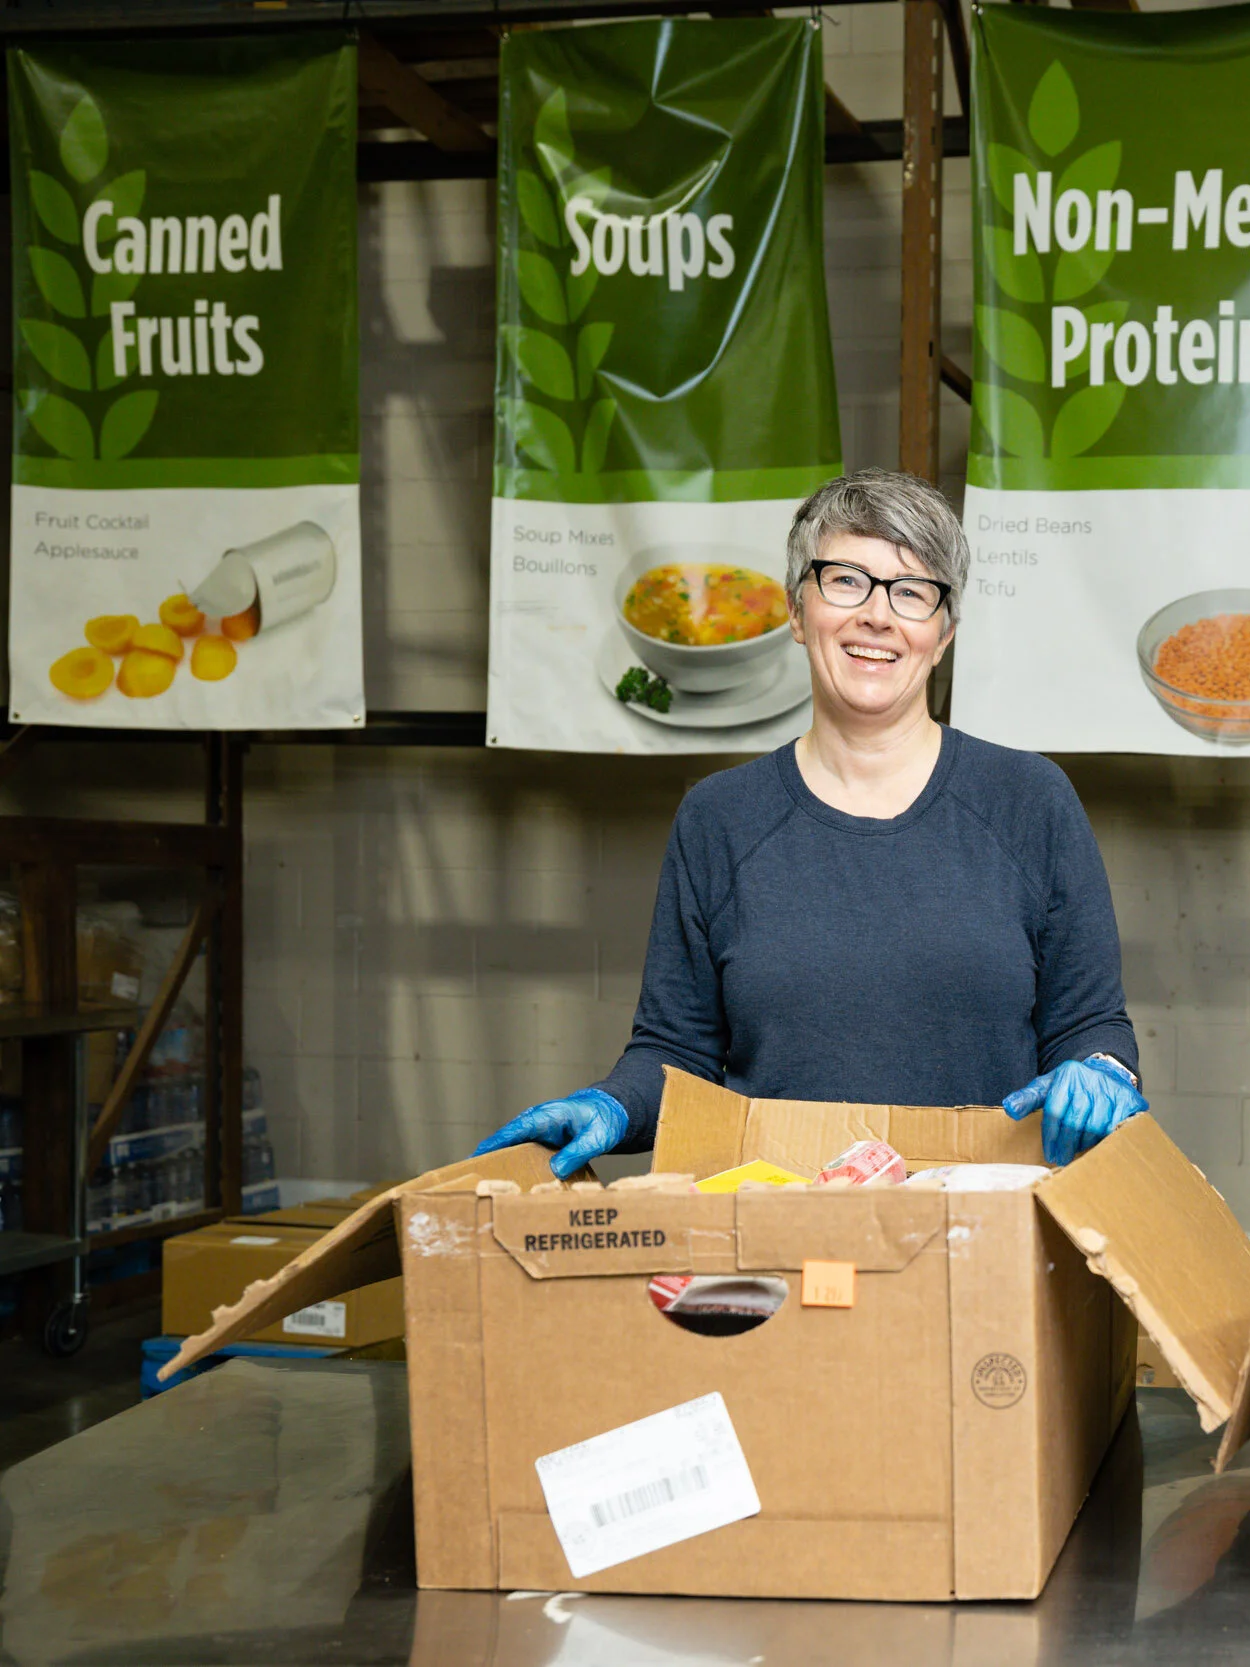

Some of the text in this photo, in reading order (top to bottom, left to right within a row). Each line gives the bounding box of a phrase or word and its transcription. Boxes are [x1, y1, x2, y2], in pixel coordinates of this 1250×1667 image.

[82, 194, 283, 274] Canned
[564, 197, 735, 292] Soups
[110, 299, 264, 377] Fruits
[35, 511, 150, 530] Fruit Cocktail
[978, 514, 1092, 534] Dried Beans
[513, 525, 615, 546] Soup Mixes
[34, 541, 139, 560] Applesauce
[976, 548, 1039, 566] Lentils
[513, 556, 597, 576] Bouillons
[976, 578, 1016, 597] Tofu
[569, 1208, 619, 1228] KEEP
[524, 1229, 667, 1253] REFRIGERATED
